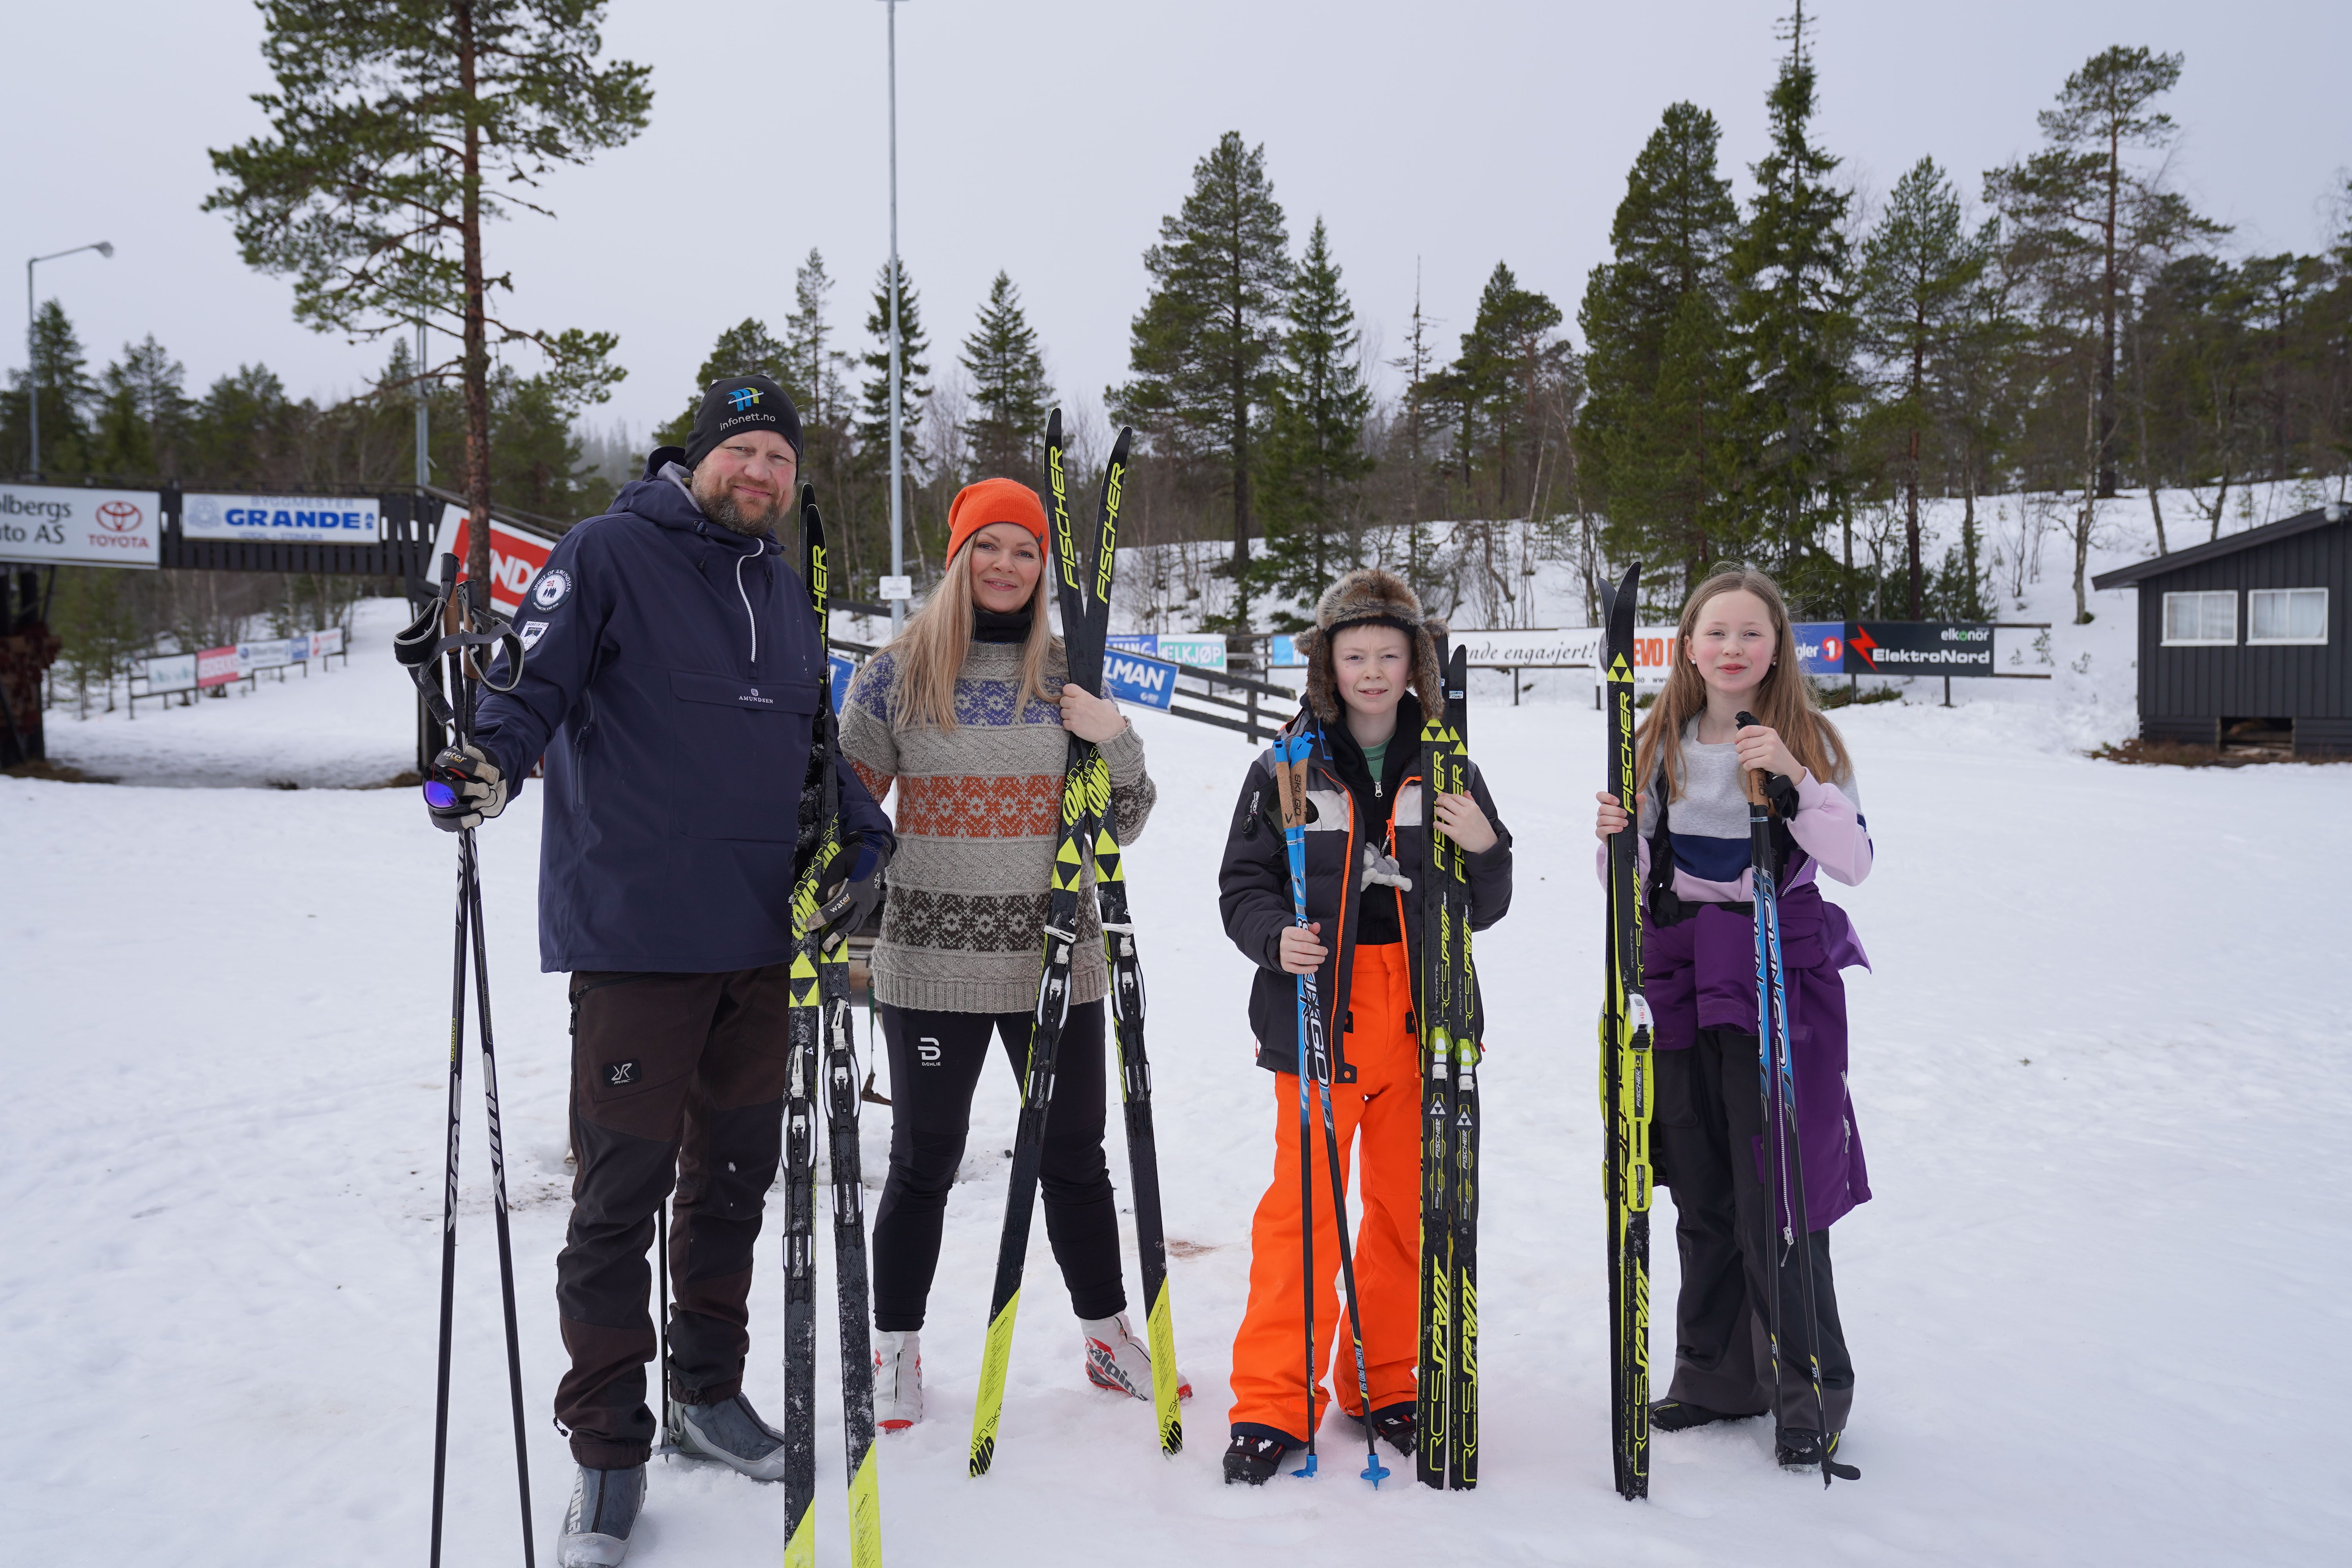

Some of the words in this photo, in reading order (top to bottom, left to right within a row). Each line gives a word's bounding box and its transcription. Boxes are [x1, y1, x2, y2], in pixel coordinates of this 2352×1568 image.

[0, 493, 73, 523] lbergs
[225, 509, 360, 530] GRANDE
[251, 495, 354, 509] BYGGMESTER
[1050, 446, 1079, 590] FISCHER
[34, 524, 65, 544] AS
[88, 534, 150, 548] TOYOTA
[1096, 462, 1125, 604] FISCHER
[533, 575, 546, 591] SPIRIT
[555, 569, 571, 592] AMUNDSEN
[1504, 641, 1597, 665] engasjert!
[1872, 648, 1990, 664] ElektroNord
[739, 695, 773, 704] AMUNDSEN
[443, 751, 467, 762] water
[1620, 691, 1634, 815] FISCHER
[1086, 758, 1112, 818] COMP
[1294, 799, 1301, 816] GO
[829, 893, 850, 913] water
[1632, 867, 1643, 931] SPRINT
[1441, 904, 1450, 968] SPRINT
[1463, 916, 1473, 980] SPRINT
[1635, 928, 1645, 987] RCS
[1441, 964, 1450, 1018] RCS
[1465, 976, 1474, 1029] RCS
[994, 1319, 1006, 1336] FISCHER
[1432, 1254, 1450, 1376] SPRINT
[1462, 1266, 1478, 1388] SPRINT
[1635, 1256, 1650, 1378] SPRINT
[1354, 1347, 1364, 1369] RACING
[1357, 1368, 1366, 1382] PRO
[1429, 1370, 1446, 1472] RCS
[1463, 1381, 1477, 1482] RCS
[1634, 1372, 1649, 1476] RCS
